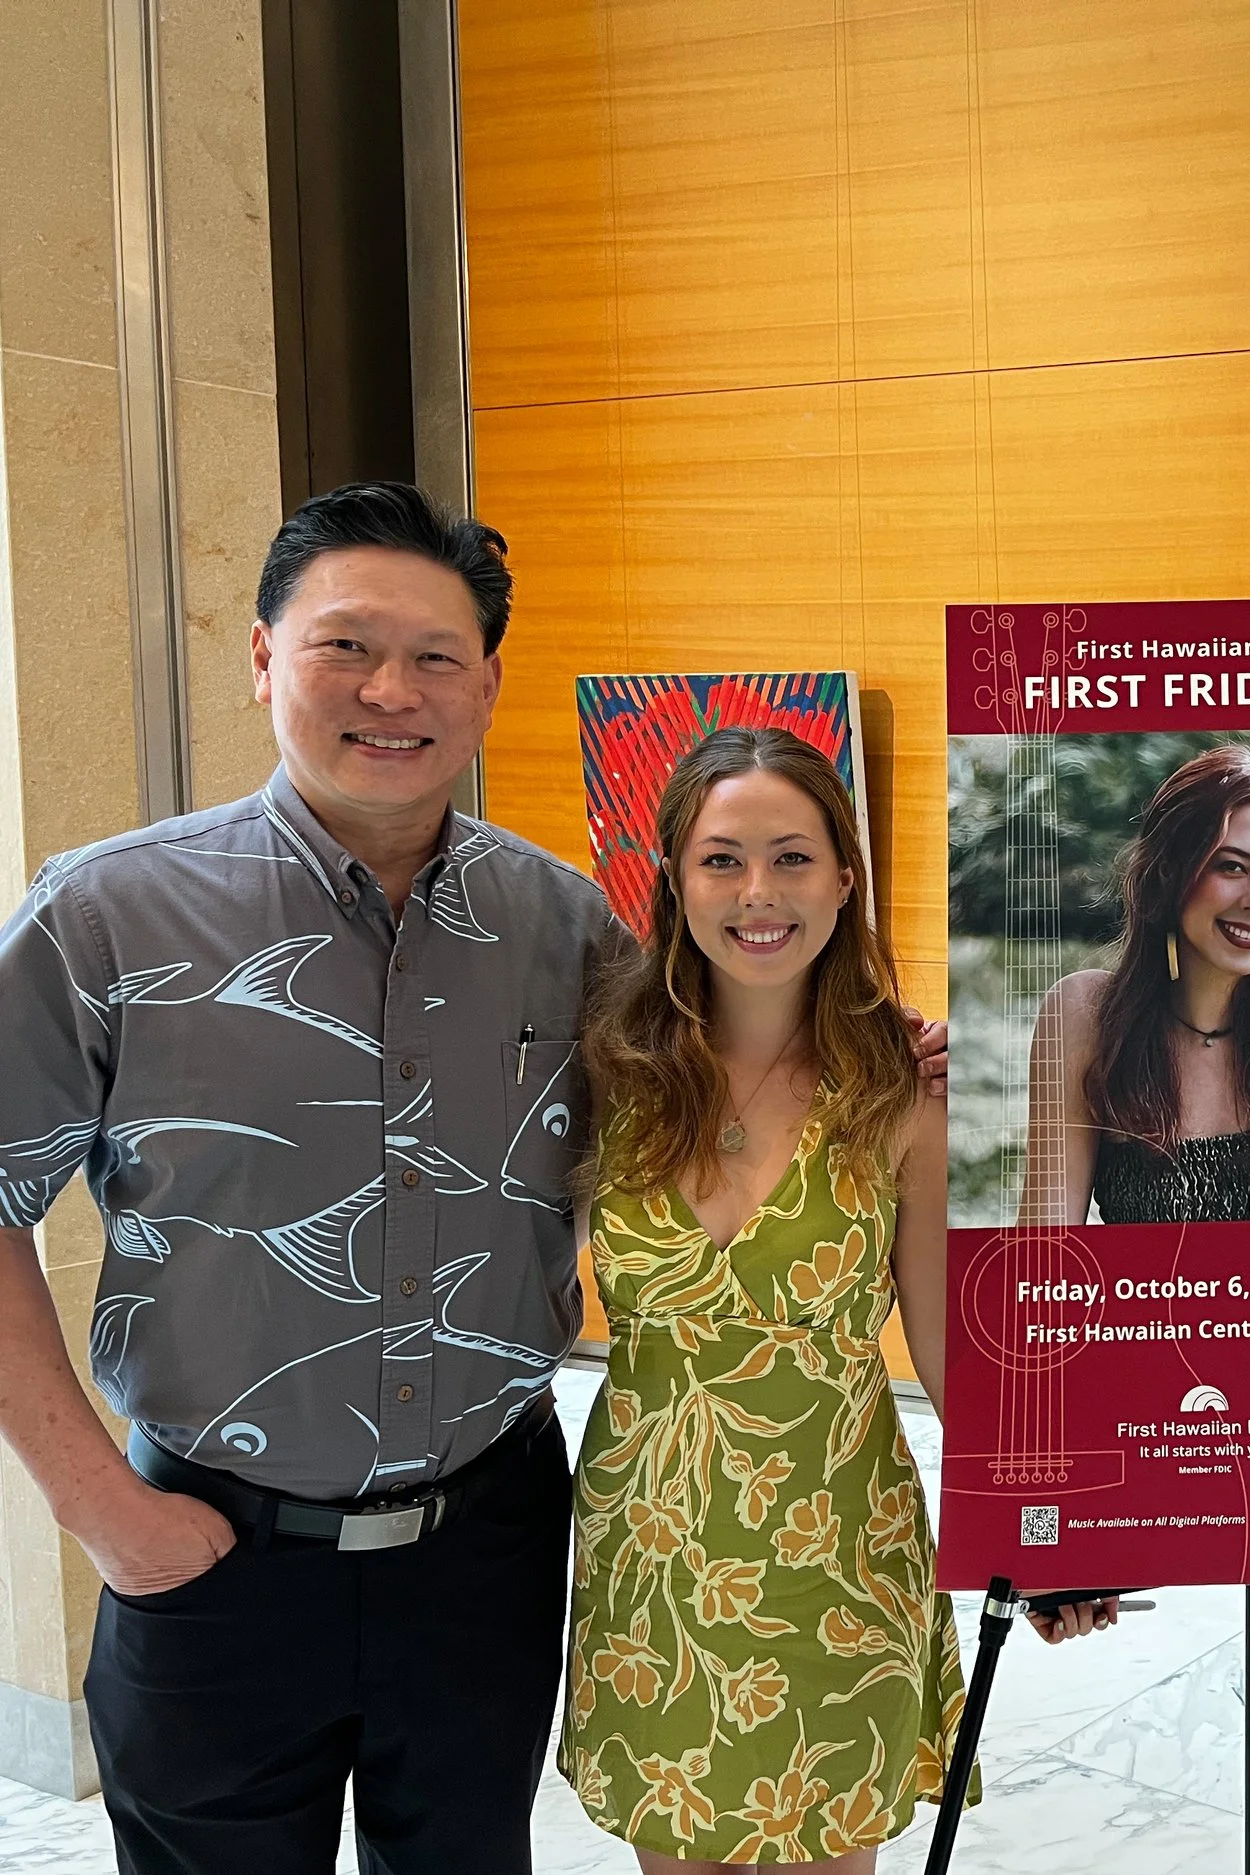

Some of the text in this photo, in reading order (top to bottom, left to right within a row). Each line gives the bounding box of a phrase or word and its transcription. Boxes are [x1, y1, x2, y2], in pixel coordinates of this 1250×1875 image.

[1077, 640, 1134, 660] First
[1025, 674, 1146, 709] FIRST
[1017, 1280, 1106, 1305] Friday,
[1115, 1276, 1221, 1300] October
[1227, 1275, 1250, 1300] 6,
[1026, 1324, 1078, 1343] First
[1084, 1320, 1191, 1342] Hawaiian
[1117, 1422, 1158, 1438] First
[1163, 1421, 1242, 1437] Hawaiian
[1140, 1446, 1150, 1458] It
[1152, 1444, 1169, 1458] all
[1172, 1445, 1211, 1458] starts
[1213, 1444, 1244, 1457] with
[1178, 1465, 1232, 1474] Member FDIC
[1067, 1514, 1246, 1529] Music Available on All Digital Platforms
